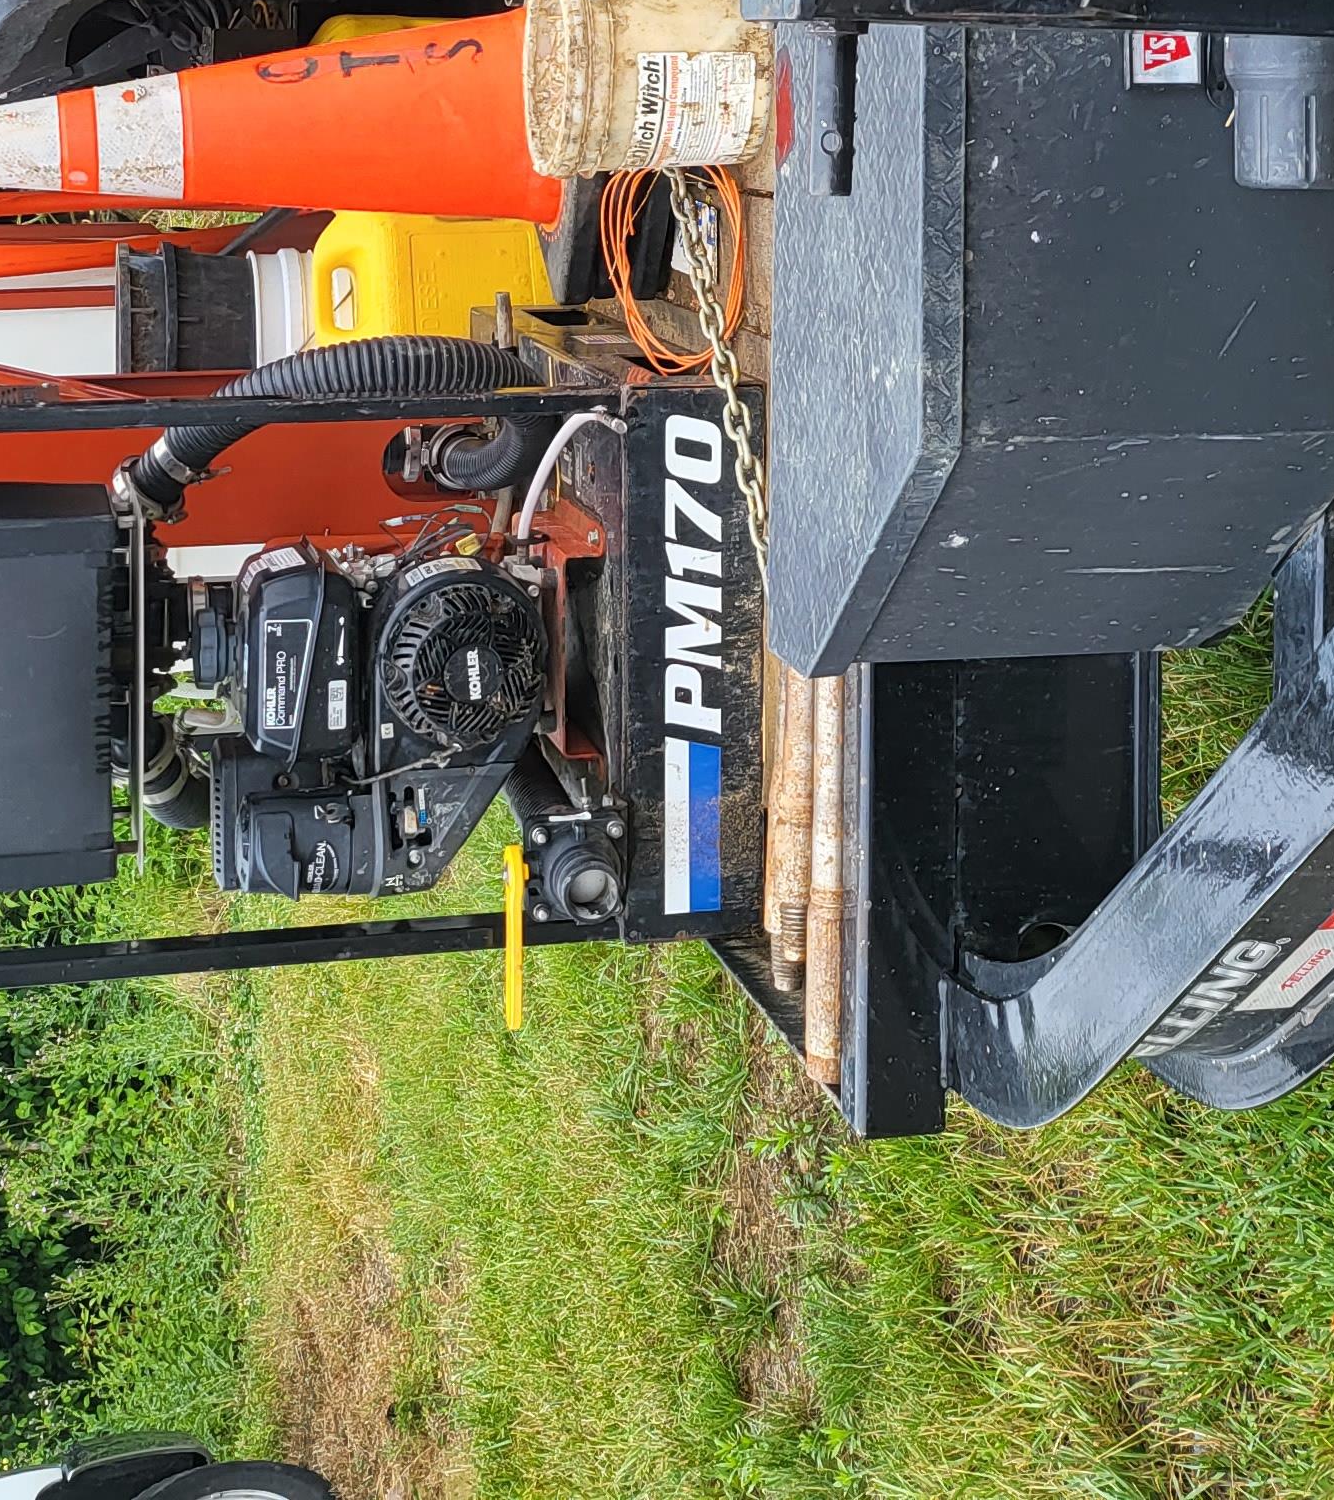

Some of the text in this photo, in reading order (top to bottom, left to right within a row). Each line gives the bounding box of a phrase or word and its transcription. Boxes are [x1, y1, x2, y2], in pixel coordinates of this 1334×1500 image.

[631, 60, 660, 159] Ditch Witch
[668, 55, 679, 100] Compound
[416, 261, 441, 331] DIESEL
[664, 415, 723, 735] PM170
[266, 687, 276, 726] KOHLER
[275, 650, 287, 726] Command PRO
[466, 650, 482, 700] KOHLER
[1130, 939, 1282, 1057] ELLING
[1280, 948, 1332, 991] FELLING
